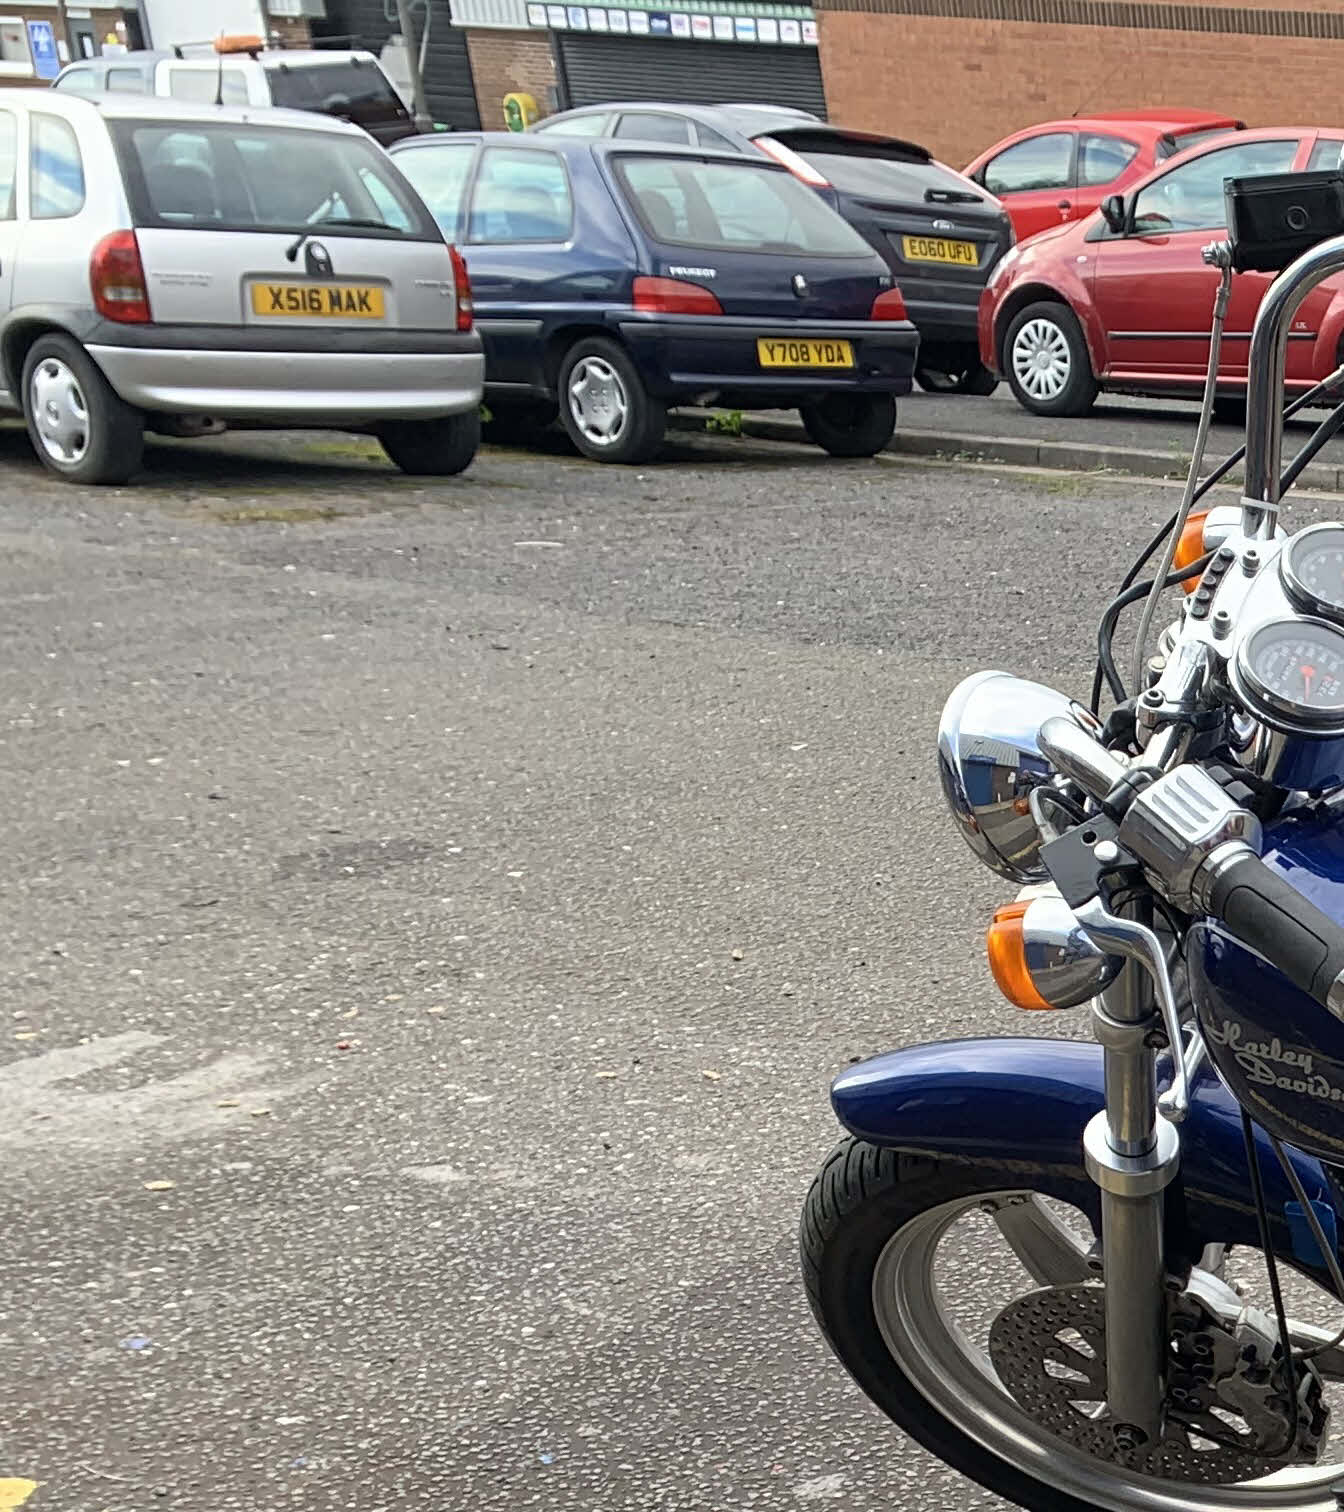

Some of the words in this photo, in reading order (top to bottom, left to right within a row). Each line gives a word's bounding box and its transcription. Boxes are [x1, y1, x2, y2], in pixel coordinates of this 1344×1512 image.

[269, 286, 322, 311] X516
[327, 289, 373, 313] MAK
[764, 342, 809, 363] Y708
[816, 344, 846, 364] YDA
[1203, 1020, 1313, 1074] Harley
